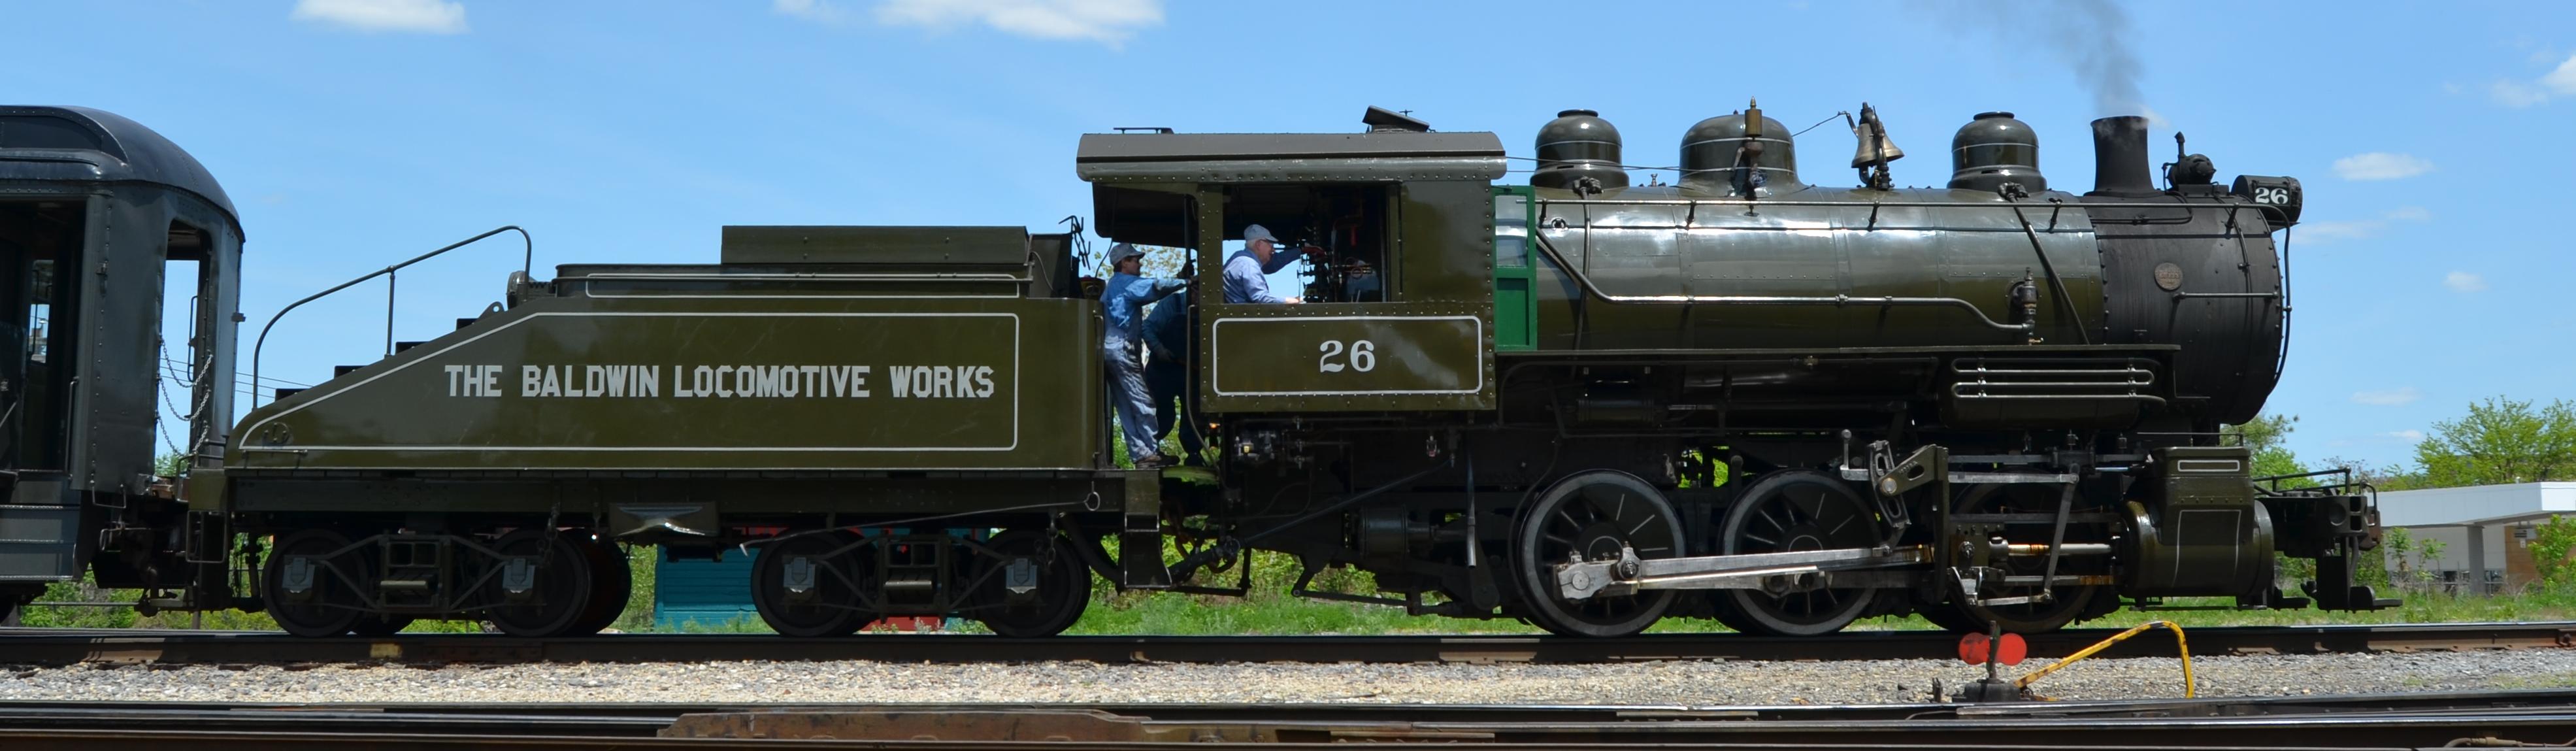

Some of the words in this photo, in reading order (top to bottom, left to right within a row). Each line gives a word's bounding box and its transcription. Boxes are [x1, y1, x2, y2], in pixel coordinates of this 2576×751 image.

[2255, 187, 2288, 205] 26
[1319, 340, 1376, 373] 26
[444, 365, 503, 397] THE
[521, 365, 659, 397] BALDWIN
[674, 365, 870, 397] LOCOMOTIVE
[889, 365, 995, 398] WORKS
